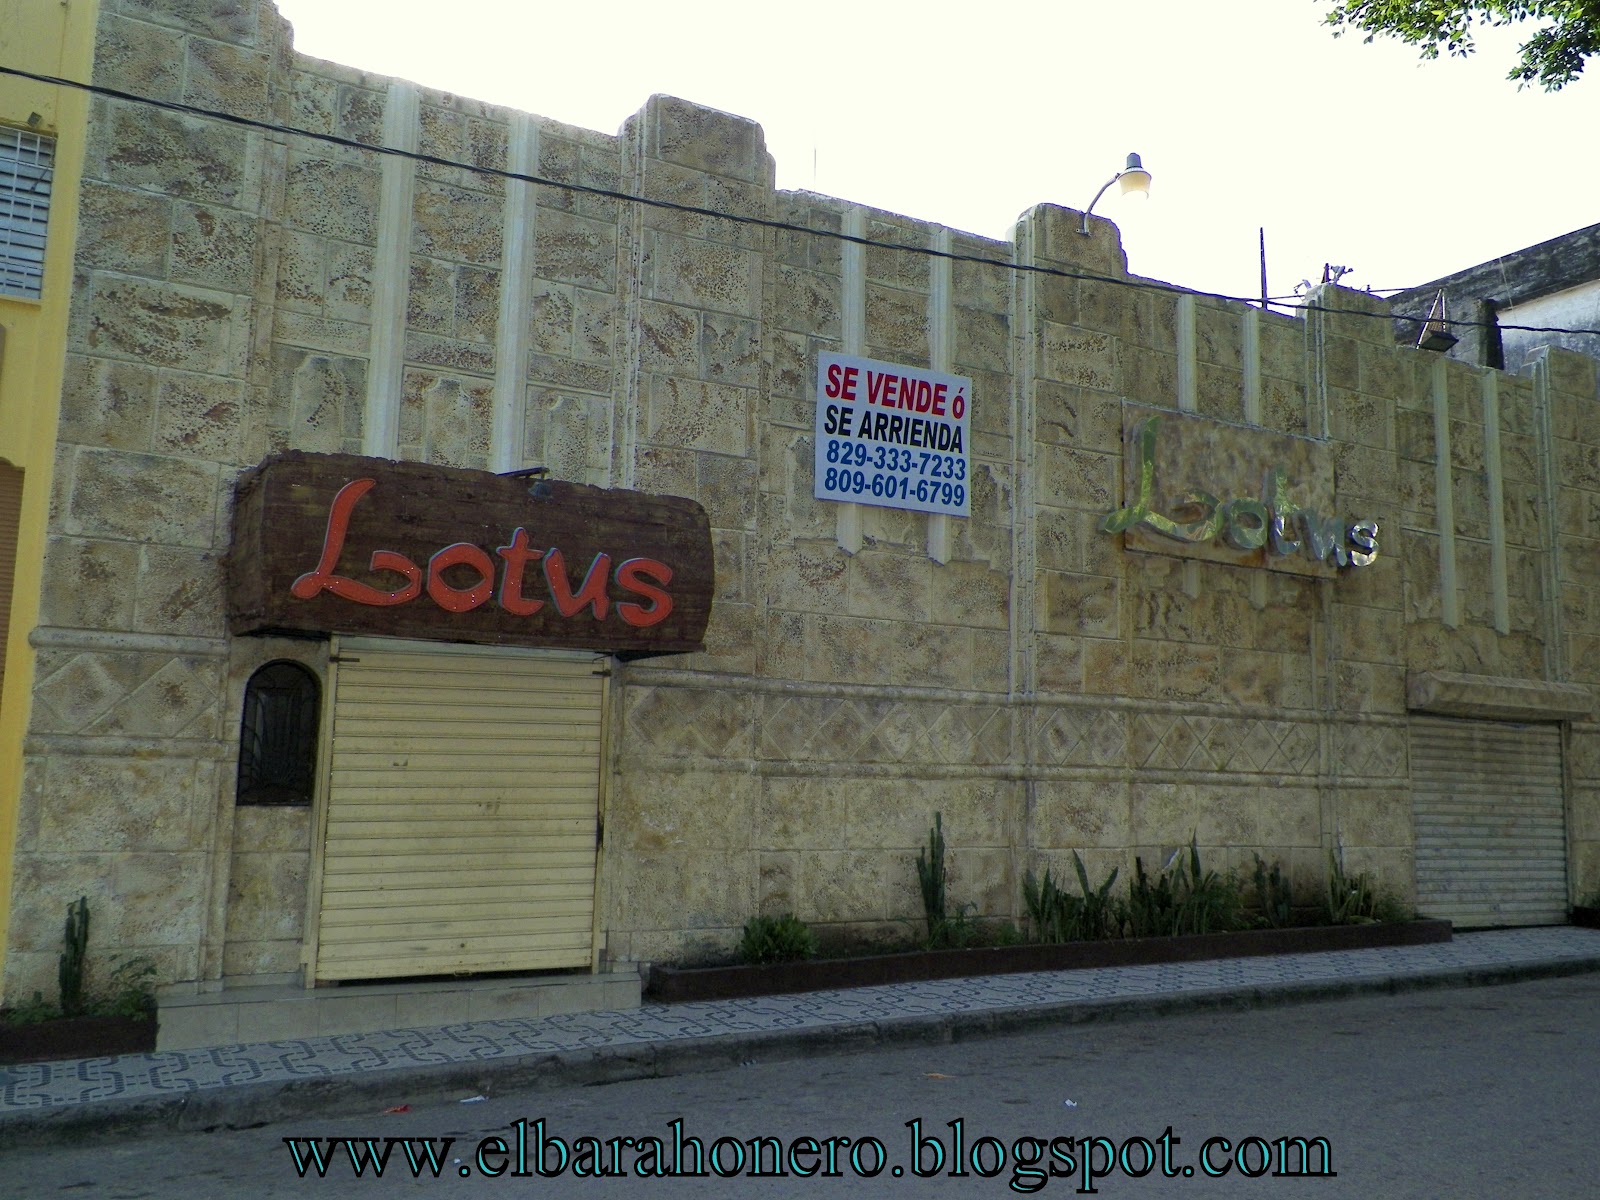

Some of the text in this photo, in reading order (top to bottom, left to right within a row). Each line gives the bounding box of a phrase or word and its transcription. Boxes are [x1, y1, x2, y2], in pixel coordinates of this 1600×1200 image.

[825, 364, 859, 401] SE
[867, 370, 948, 417] VENDE
[824, 404, 963, 454] SE ARRIENDA
[826, 439, 966, 481] 829-333-7233
[824, 467, 965, 507] 809-601-6799
[1102, 415, 1379, 567] Lotus
[290, 477, 673, 627] Lotus
